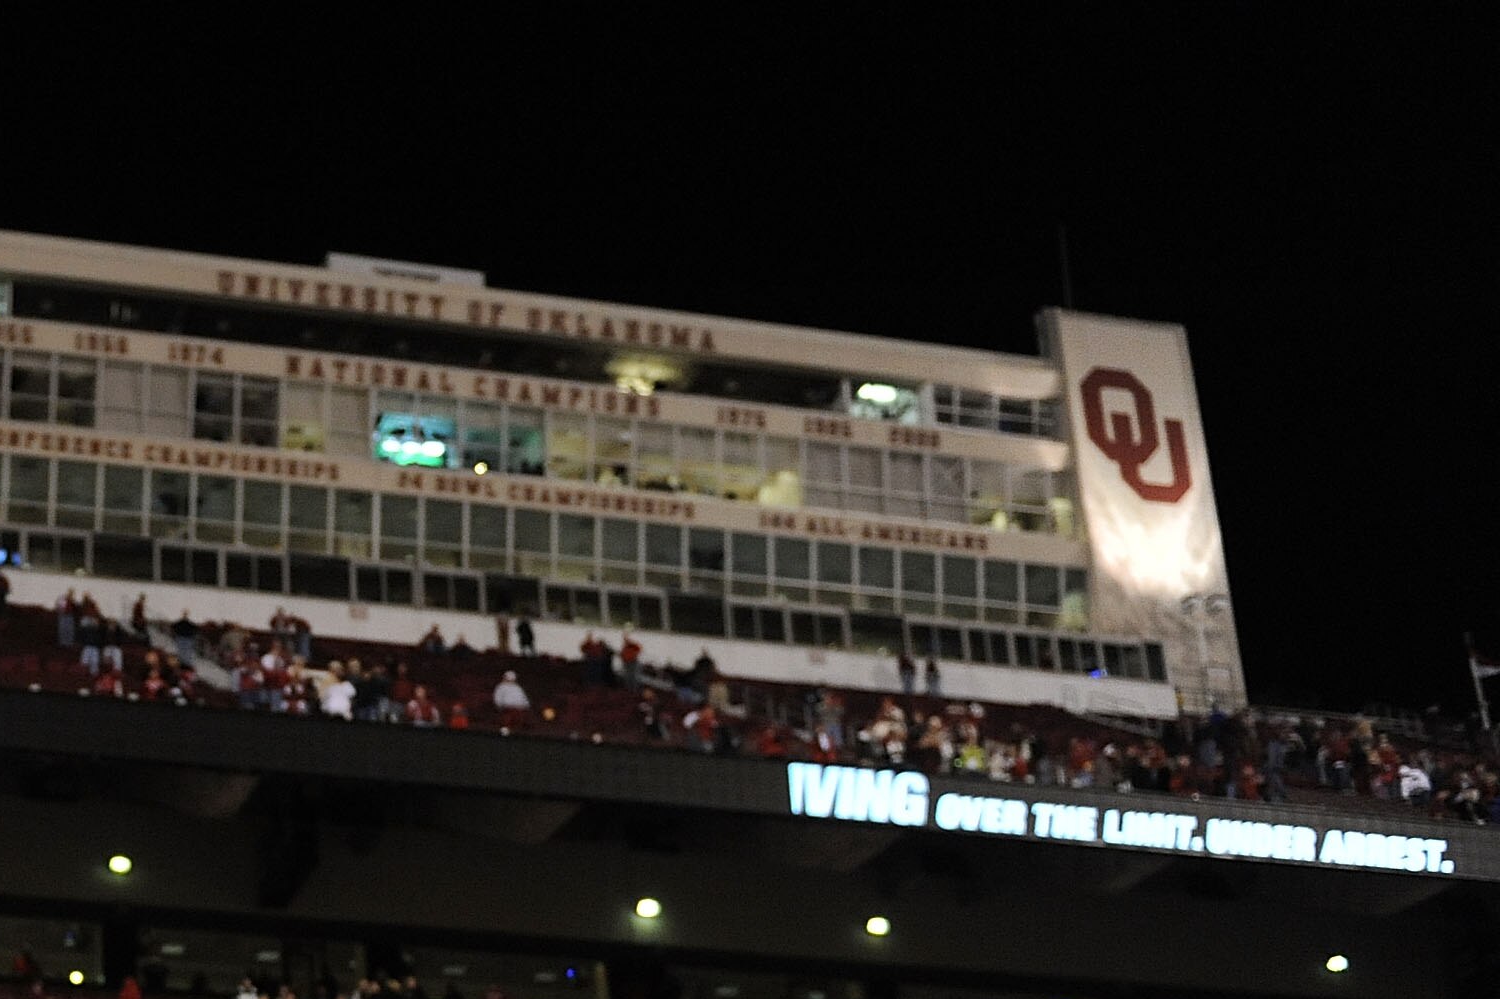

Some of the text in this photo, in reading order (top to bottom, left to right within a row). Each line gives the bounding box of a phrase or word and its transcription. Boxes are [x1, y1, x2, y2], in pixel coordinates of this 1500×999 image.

[217, 270, 715, 350] UNIVERSITY OF OKLAHOMA
[286, 355, 452, 394] NATIONAL
[474, 376, 659, 417] CHAMPIONS
[1080, 367, 1192, 502] OU
[145, 444, 339, 481] CHAMPIONSHIPS
[436, 475, 495, 498] BOWL
[508, 484, 696, 519] CHAMPIONSHIPS
[935, 793, 1028, 836] OVER
[1031, 802, 1098, 842] THE
[1206, 818, 1317, 862] UNDER
